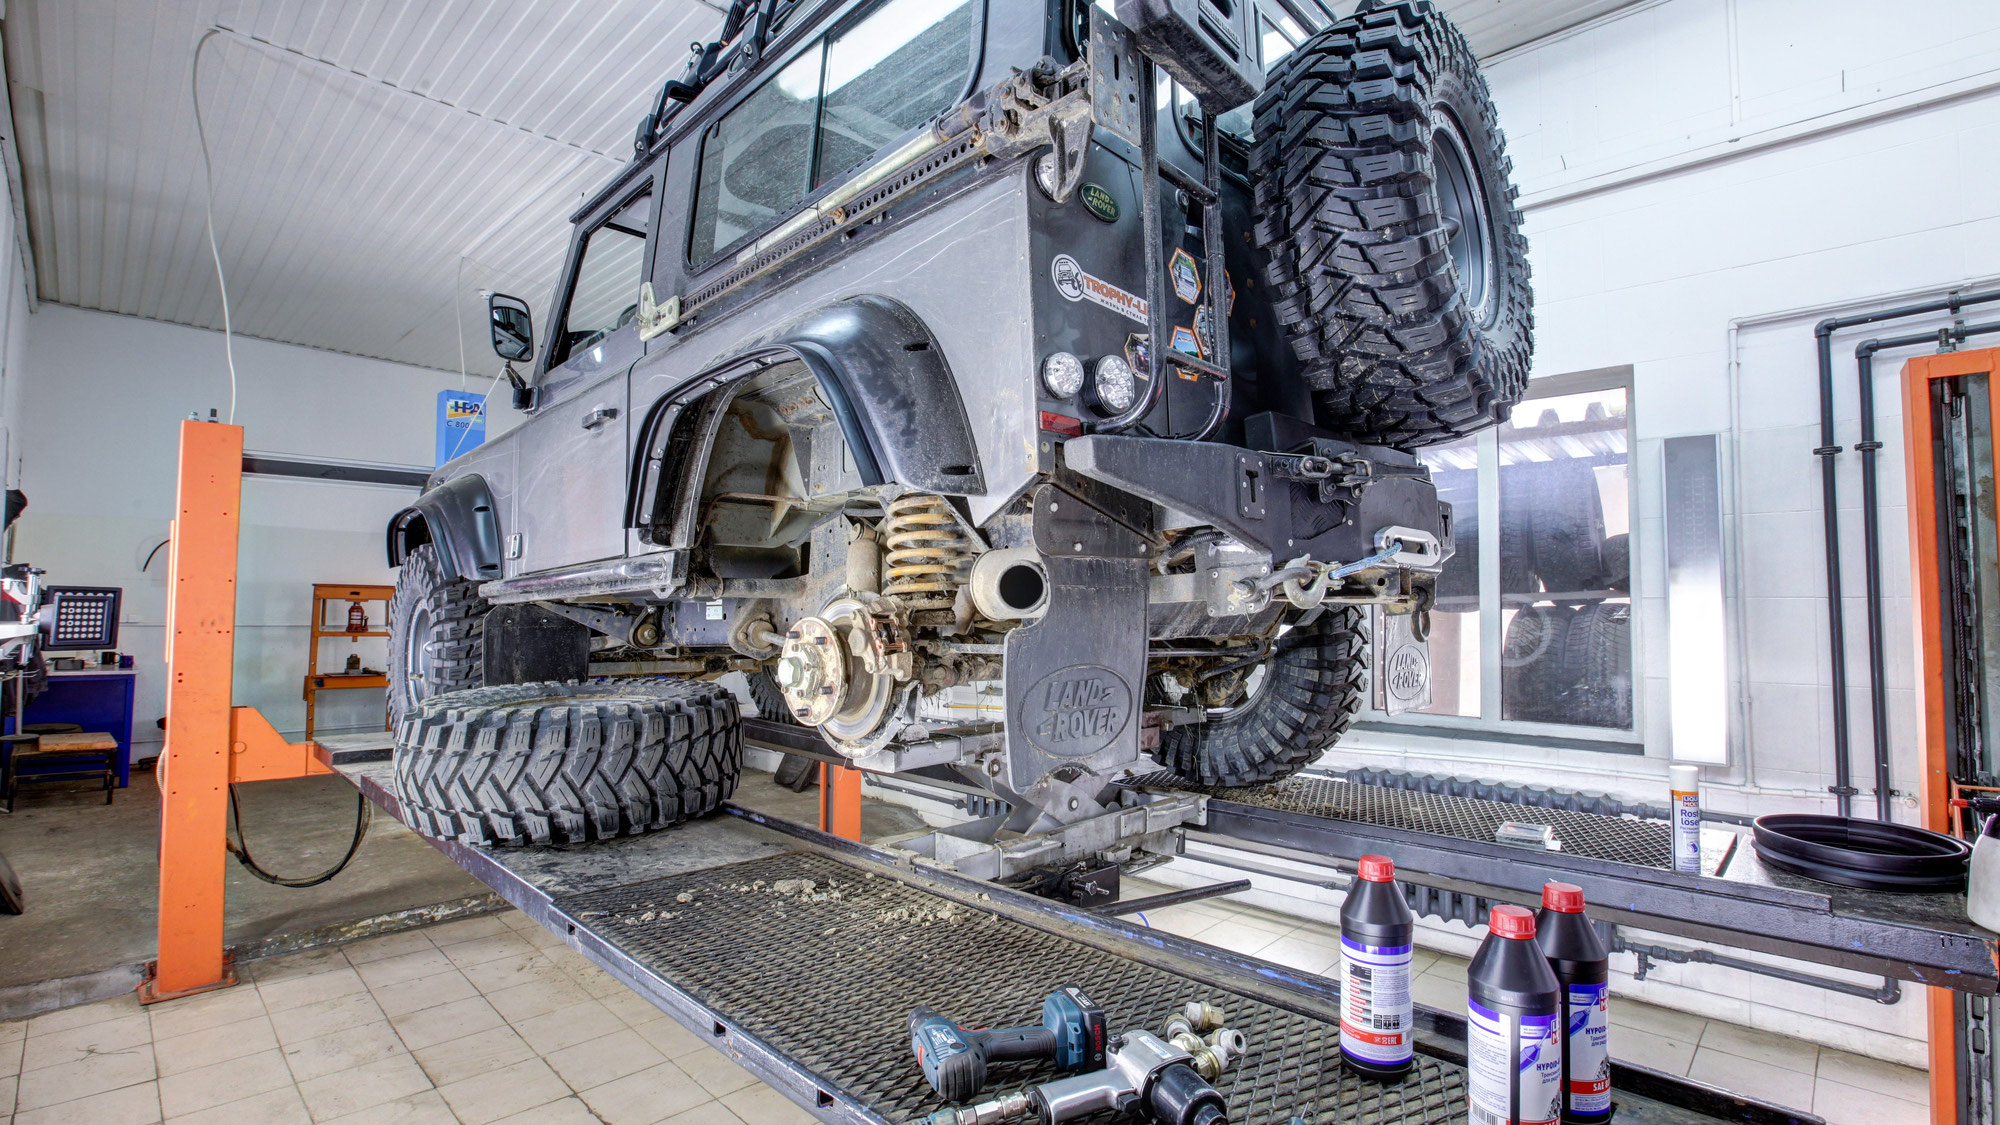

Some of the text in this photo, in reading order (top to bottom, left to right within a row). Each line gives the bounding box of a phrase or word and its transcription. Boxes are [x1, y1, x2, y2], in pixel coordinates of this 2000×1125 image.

[1090, 187, 1110, 202] LAND
[1092, 197, 1116, 216] ROVER
[1083, 275, 1147, 315] TROPHY-LI
[1043, 679, 1103, 712] LAND
[1052, 707, 1119, 742] ROVER
[1681, 817, 1699, 826] löse
[1094, 1024, 1102, 1051] BOSCH
[1593, 1081, 1604, 1091] SAE
